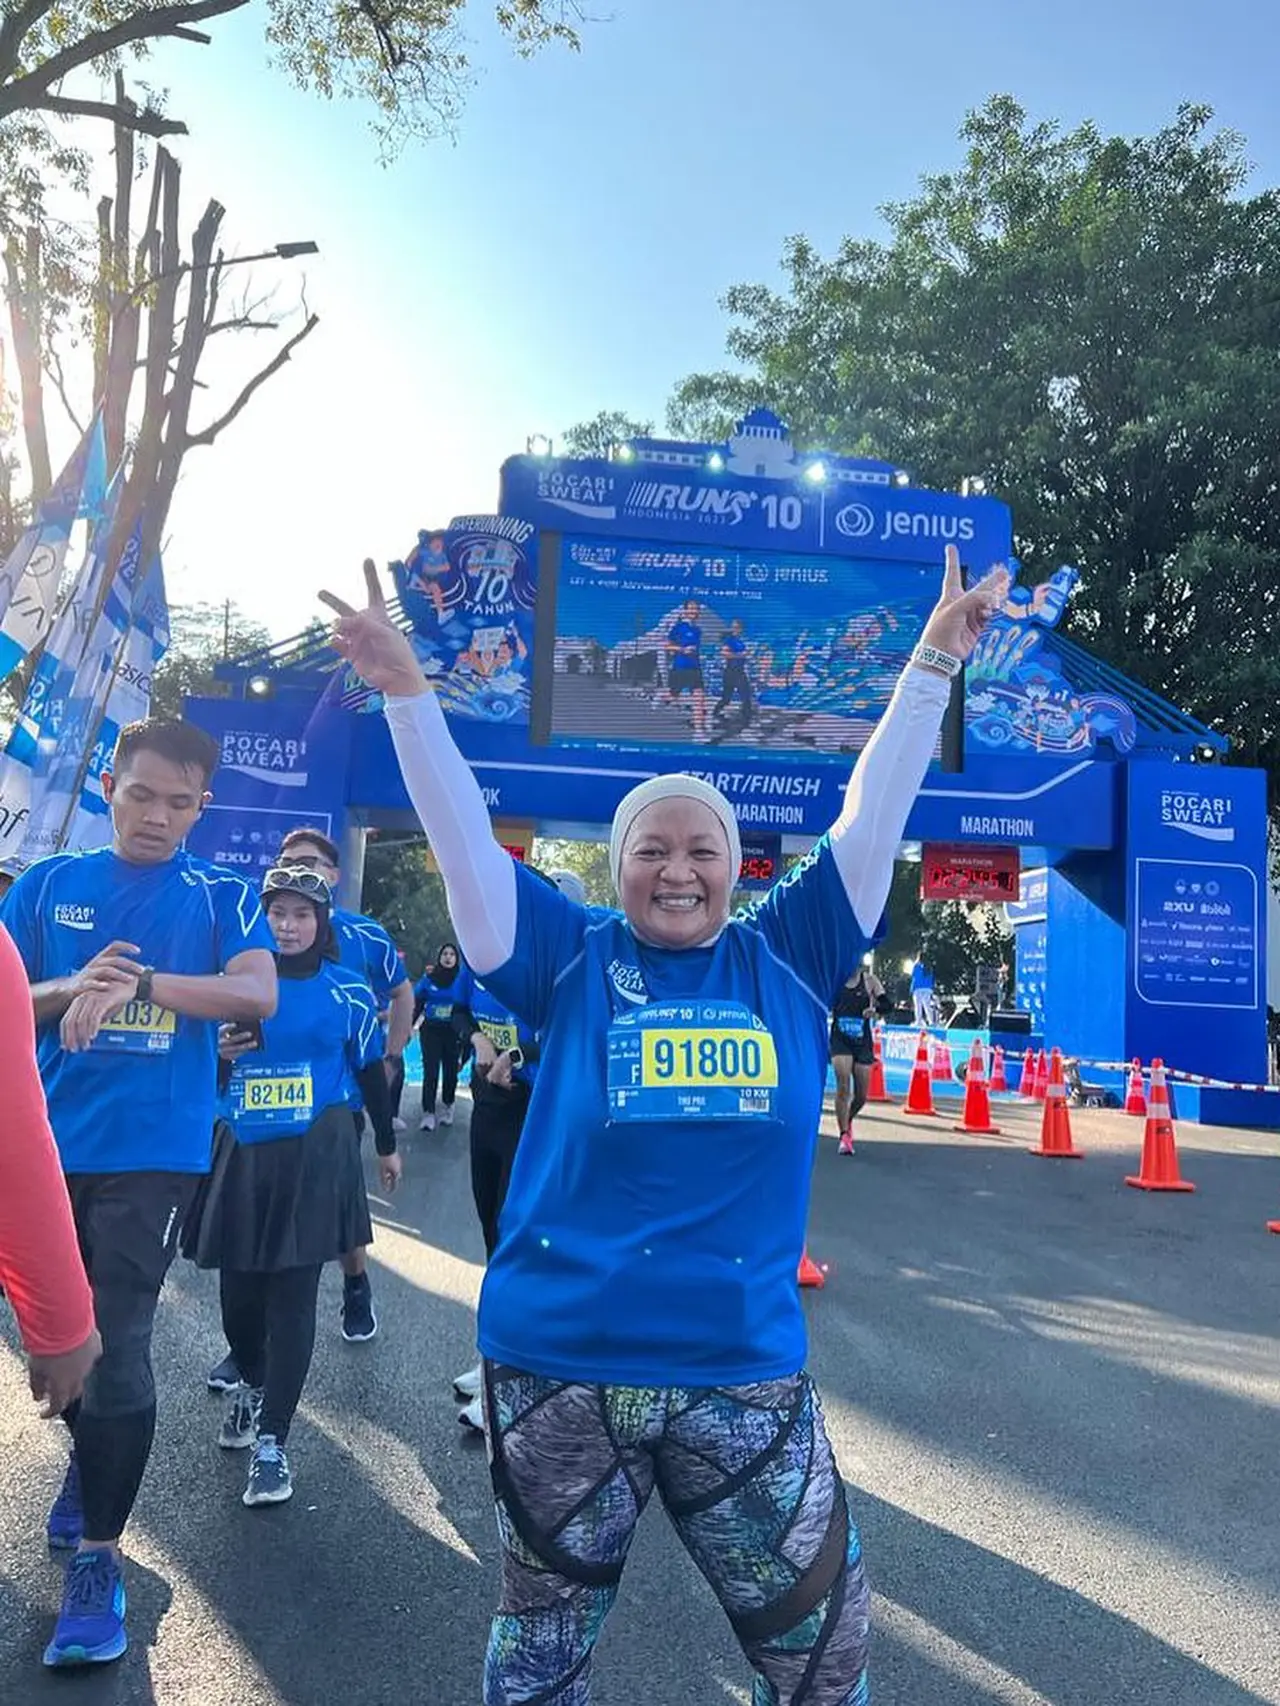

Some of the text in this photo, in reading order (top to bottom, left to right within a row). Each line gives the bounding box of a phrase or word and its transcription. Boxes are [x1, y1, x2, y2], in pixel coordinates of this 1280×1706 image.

[537, 483, 607, 503] SWEAT
[761, 495, 802, 530] 10
[474, 567, 509, 604] 10
[464, 600, 515, 615] TAHUN
[223, 736, 307, 755] POCARI
[221, 749, 298, 768] SWEAT
[1161, 795, 1231, 812] POCARI
[961, 806, 1035, 837] MARATHON
[1161, 808, 1225, 824] SWEAT
[654, 1038, 762, 1079] 91800
[631, 1063, 641, 1085] F
[251, 1083, 306, 1105] 82144
